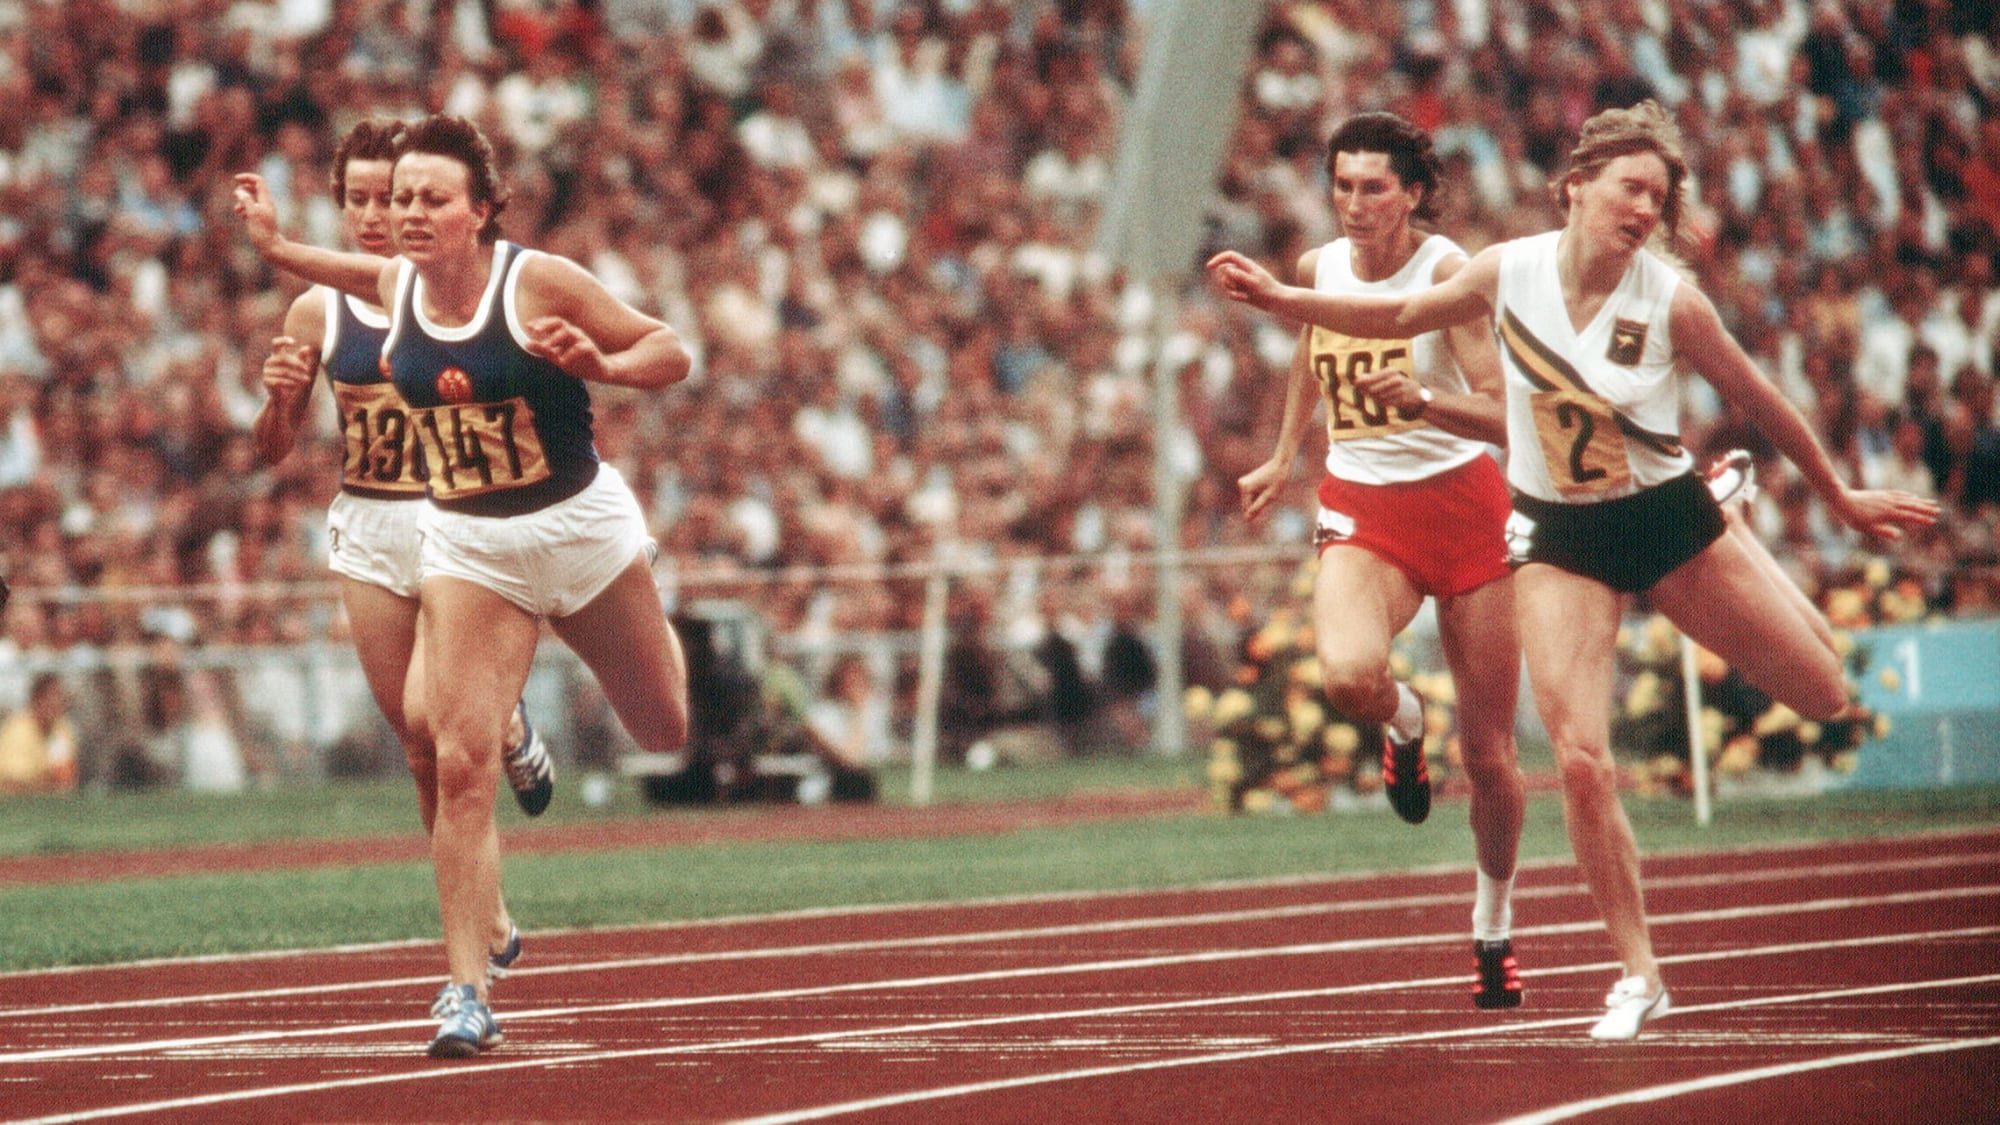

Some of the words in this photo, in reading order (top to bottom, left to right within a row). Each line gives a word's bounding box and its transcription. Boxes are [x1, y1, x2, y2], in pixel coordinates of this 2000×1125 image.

[421, 401, 523, 490] 147
[1556, 401, 1607, 484] 2
[1894, 637, 1920, 702] 1
